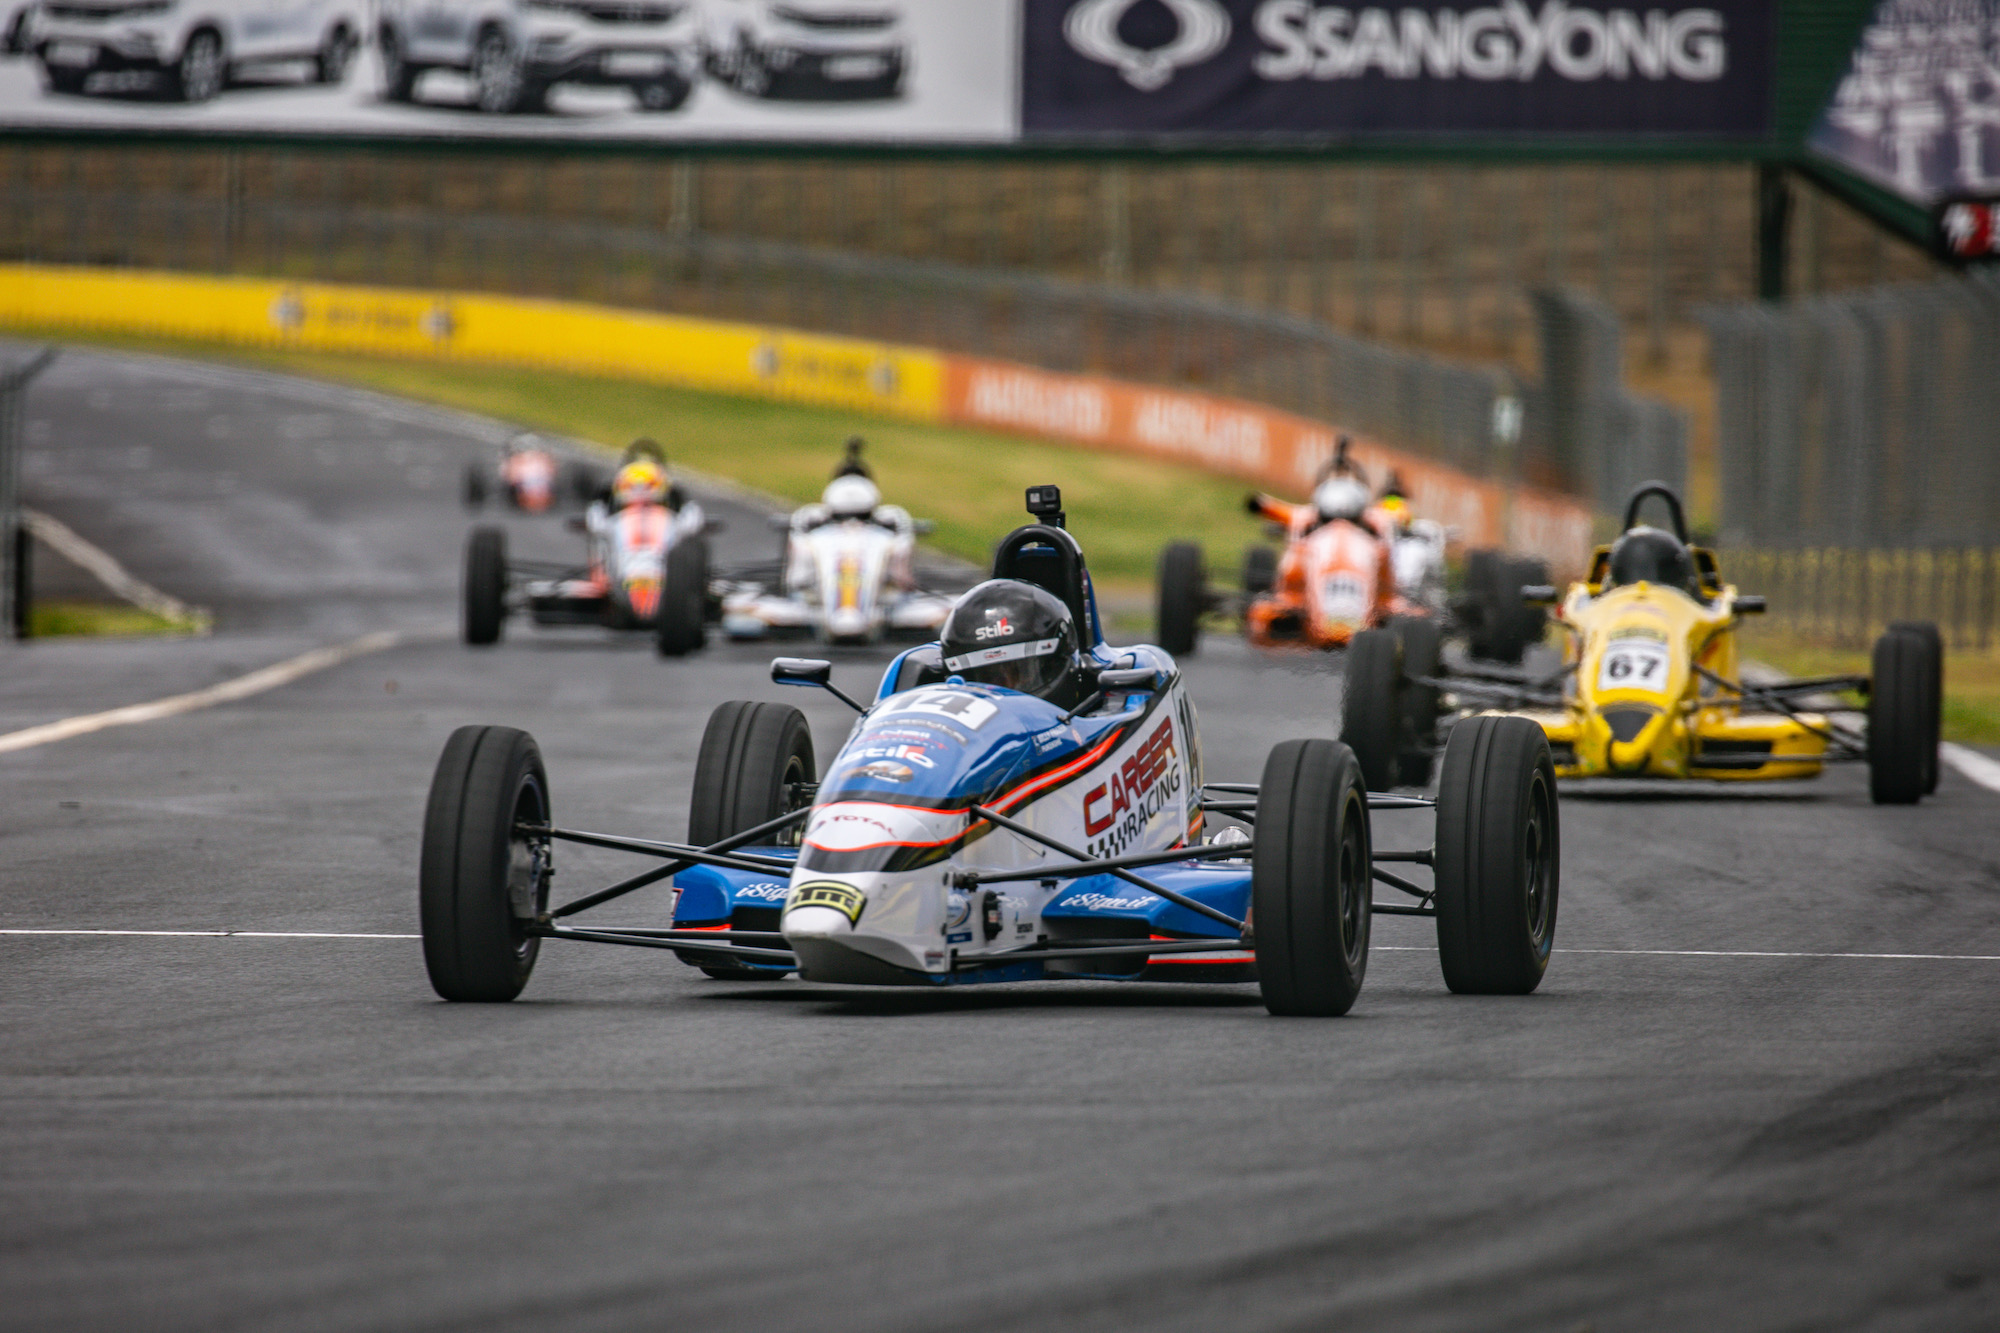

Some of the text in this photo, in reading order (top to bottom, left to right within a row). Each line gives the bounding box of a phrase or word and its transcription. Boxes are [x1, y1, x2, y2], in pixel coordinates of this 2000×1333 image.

[1608, 654, 1660, 681] 67
[1083, 715, 1176, 838] CAREER
[1127, 763, 1181, 842] RACING
